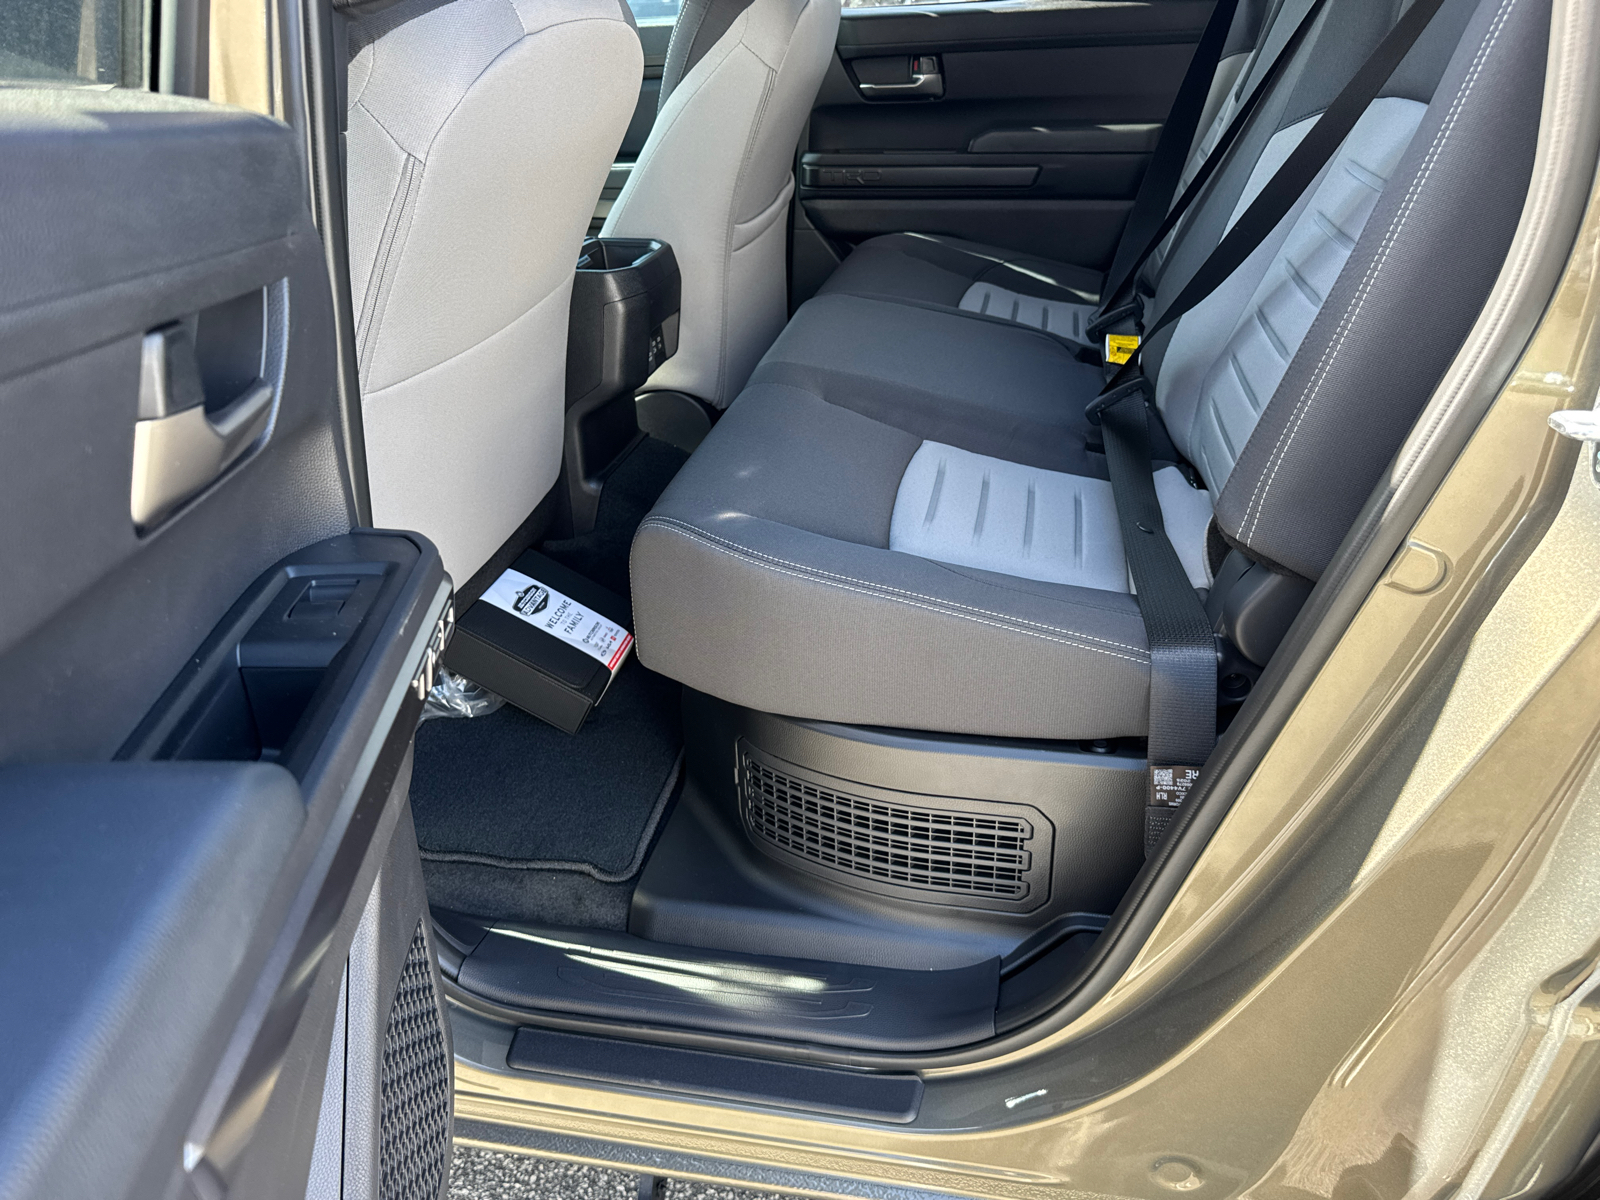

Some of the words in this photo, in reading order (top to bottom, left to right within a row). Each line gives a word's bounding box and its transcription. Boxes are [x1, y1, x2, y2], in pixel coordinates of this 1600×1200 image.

[822, 168, 882, 185] TRD
[522, 587, 547, 616] ADVANTAGE
[545, 599, 572, 629] WELCOME
[564, 611, 584, 635] FAMILY
